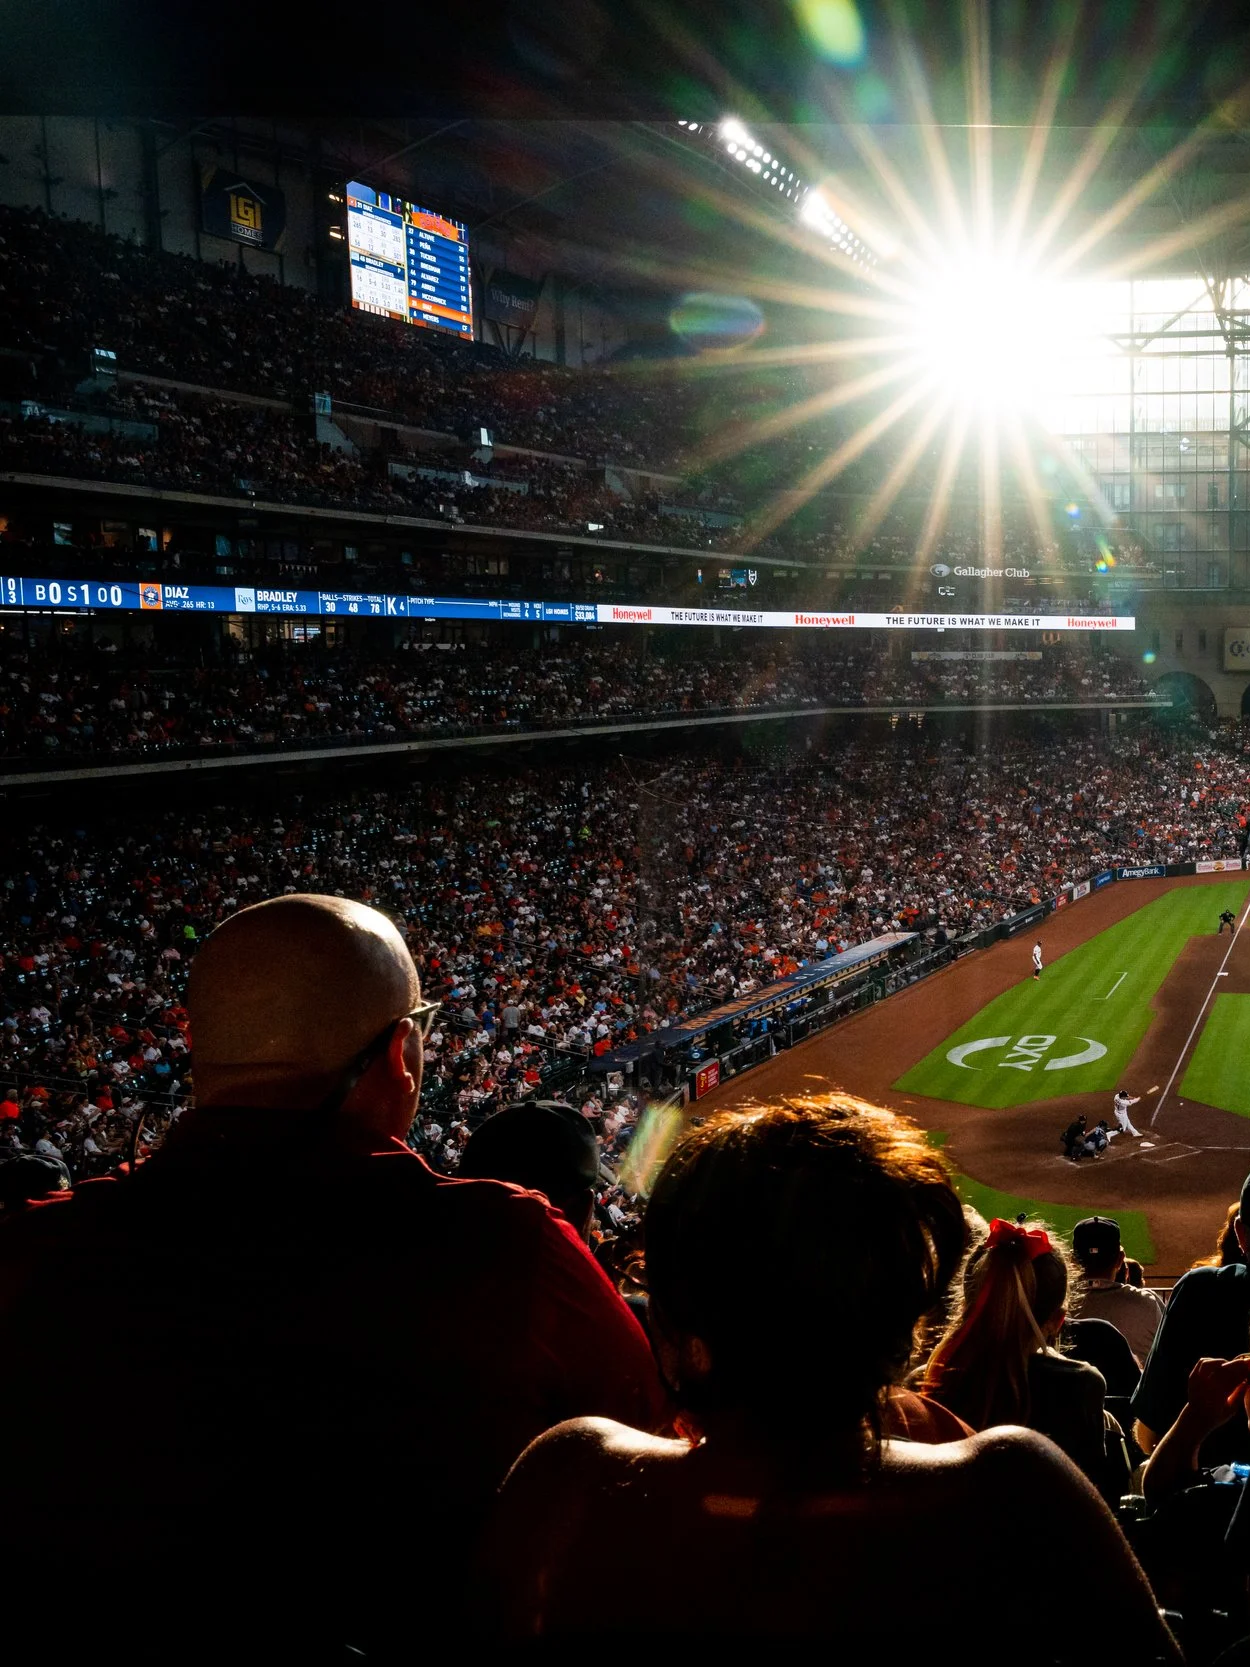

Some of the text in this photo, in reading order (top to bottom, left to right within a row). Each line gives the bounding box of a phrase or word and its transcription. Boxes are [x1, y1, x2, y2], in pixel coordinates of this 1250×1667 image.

[229, 192, 262, 230] LGI
[232, 224, 262, 239] HOMES
[491, 289, 535, 311] Why Rent?
[954, 566, 1030, 578] Gallagher Club
[8, 578, 15, 590] 0
[9, 591, 16, 603] 3
[165, 587, 189, 599] DIAZ
[257, 591, 298, 603] BRADLEY
[326, 602, 380, 613] 30 48 78
[387, 597, 397, 615] K
[400, 602, 405, 611] 4
[612, 607, 652, 623] Honeywell
[671, 611, 763, 624] THE FUTURE IS WHAT WE MAKE IT
[795, 614, 855, 627] Honeywell
[886, 616, 1041, 627] THE FUTURE IS WHAT WE MAKE IT
[1067, 617, 1117, 630] Honeywell
[1122, 867, 1160, 878] AmegyBank
[998, 1035, 1057, 1072] OXY
